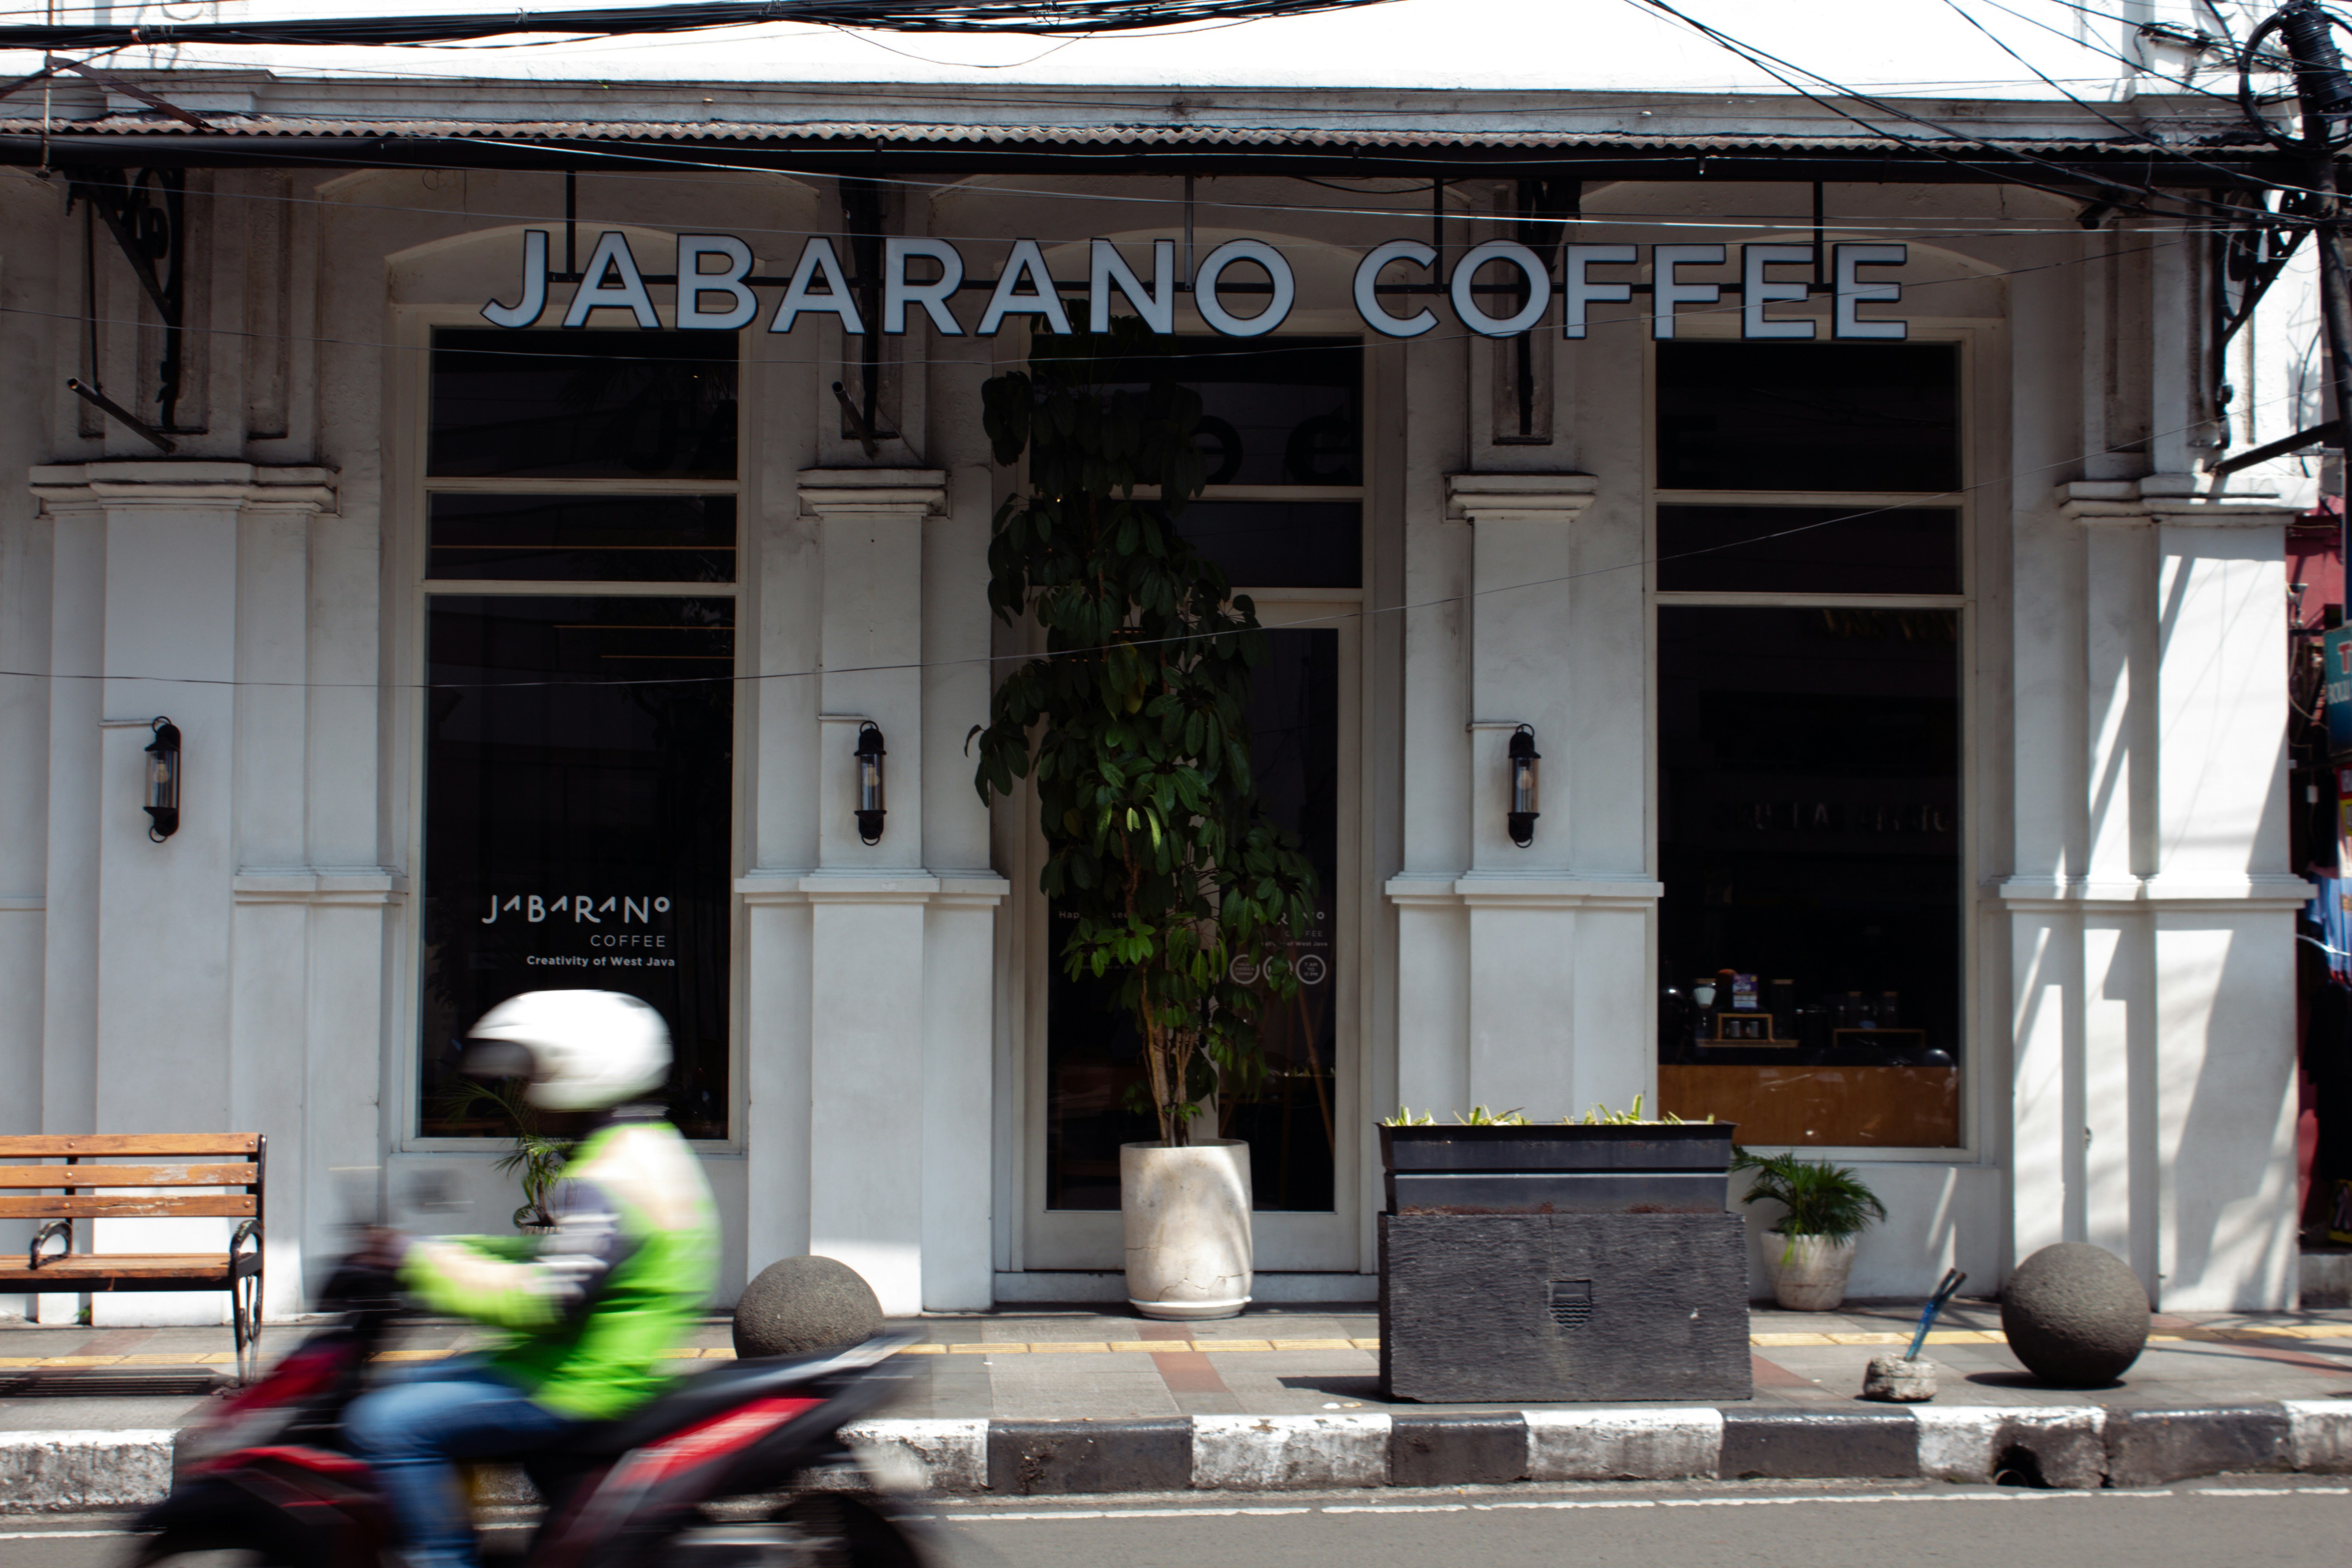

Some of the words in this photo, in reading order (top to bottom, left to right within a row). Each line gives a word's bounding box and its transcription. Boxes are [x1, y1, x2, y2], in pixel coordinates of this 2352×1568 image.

[481, 230, 1296, 337] JABARANO
[1353, 240, 1908, 338] COFFEE
[590, 935, 666, 947] COFFEE
[526, 956, 589, 967] Creativity
[593, 956, 607, 966] of
[610, 957, 642, 966] West
[646, 957, 675, 967] Java
